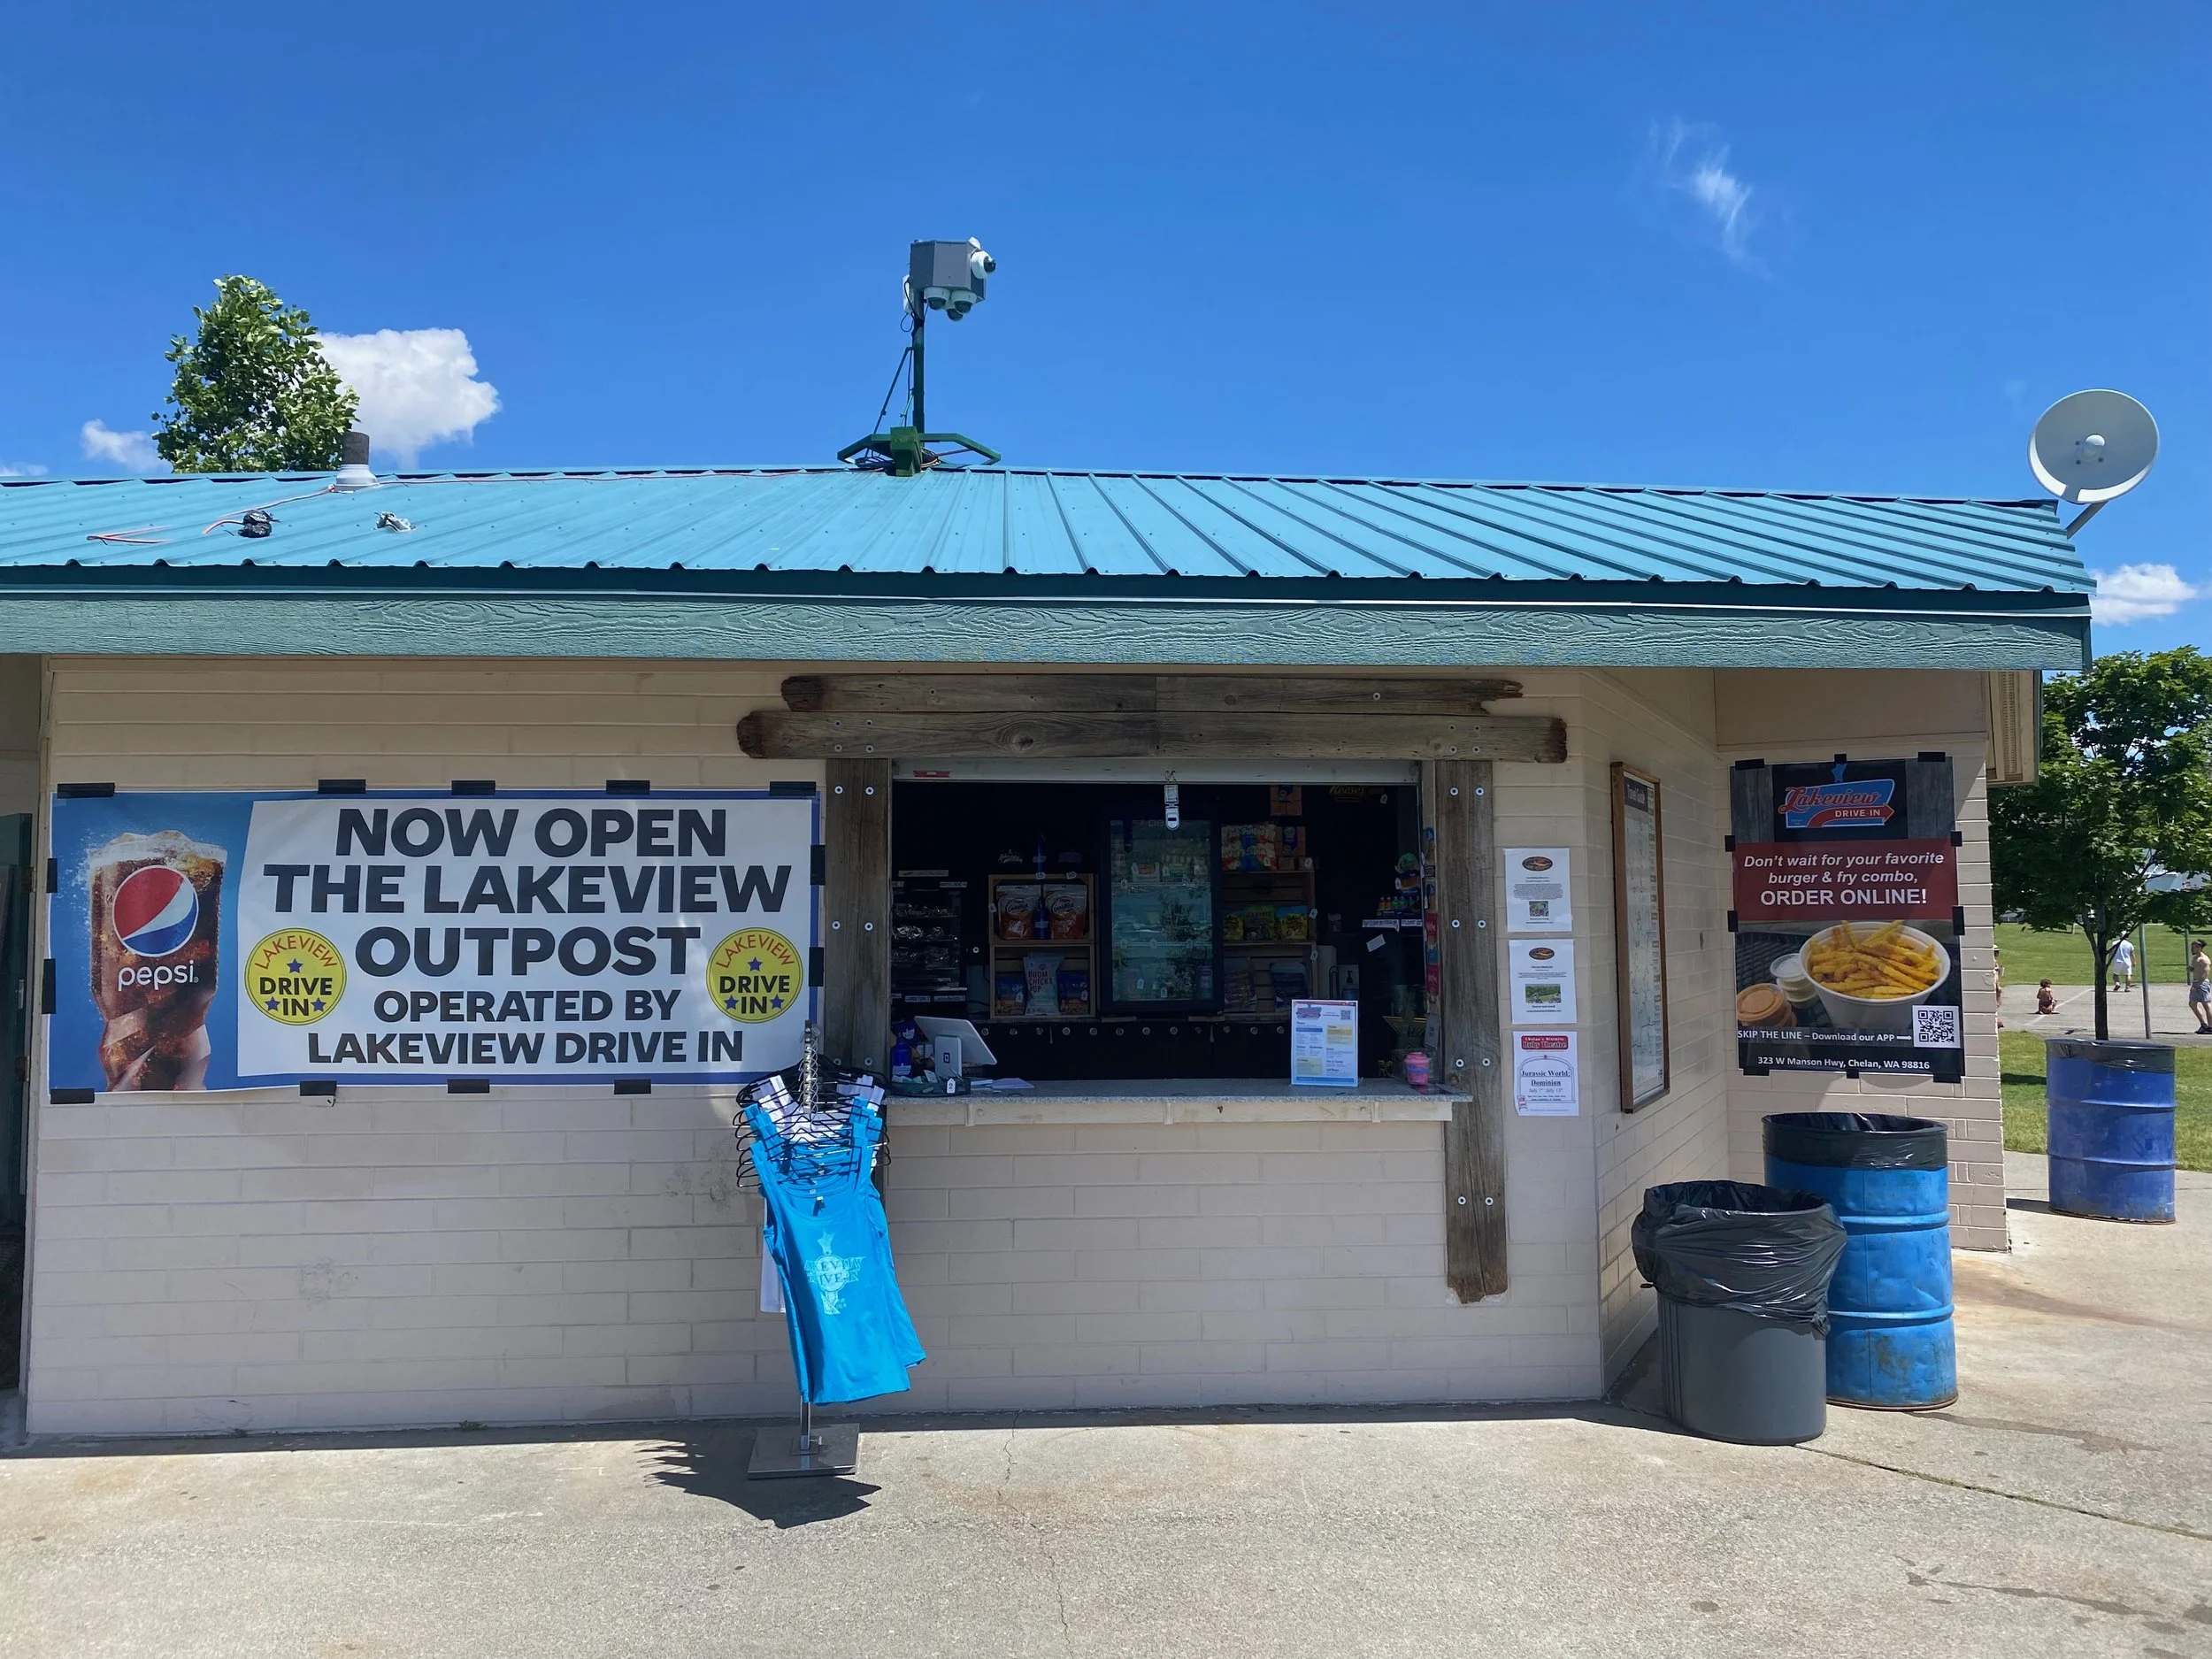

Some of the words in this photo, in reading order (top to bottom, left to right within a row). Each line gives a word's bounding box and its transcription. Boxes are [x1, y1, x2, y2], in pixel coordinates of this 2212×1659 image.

[1778, 786, 1881, 814] Lakeview
[1834, 808, 1881, 818] DRIVE-IN
[335, 807, 519, 857] NOW
[534, 807, 726, 857] OPEN
[1743, 855, 1784, 868] Don't
[1787, 854, 1818, 867] wait
[1821, 853, 1843, 865] for
[1846, 856, 1882, 869] your
[1885, 852, 1945, 864] favorite
[1768, 872, 1818, 886] burger
[1821, 872, 1832, 883] &
[1837, 871, 1858, 885] fry
[1861, 870, 1918, 884] combo,
[263, 864, 405, 913] THE
[423, 864, 792, 914] LAKEVIEW
[1760, 889, 1834, 905] ORDER
[1839, 888, 1927, 905] ONLINE!
[254, 934, 338, 970] LAKEVIEW
[355, 926, 701, 977] OUTPOST
[715, 933, 795, 969] LAKEVIEW
[118, 959, 194, 992] pepsi
[259, 976, 333, 996] DRIVE
[718, 974, 790, 995] DRIVE
[282, 997, 310, 1017] IN
[373, 989, 613, 1022] OPERATED
[625, 989, 682, 1021] BY
[740, 995, 768, 1015] IN
[1737, 1030, 1758, 1039] SKIP
[1760, 1031, 1779, 1040] THE
[1781, 1031, 1802, 1040] LINE
[1812, 1033, 1857, 1041] Download
[307, 1033, 544, 1064] LAKEVIEW
[555, 1032, 687, 1064] DRIVE
[697, 1031, 743, 1062] IN
[1786, 1057, 1822, 1066] Manson
[1824, 1058, 1847, 1068] Hwy,
[1847, 1059, 1882, 1069] Chelan,
[1901, 1060, 1930, 1069] 98816
